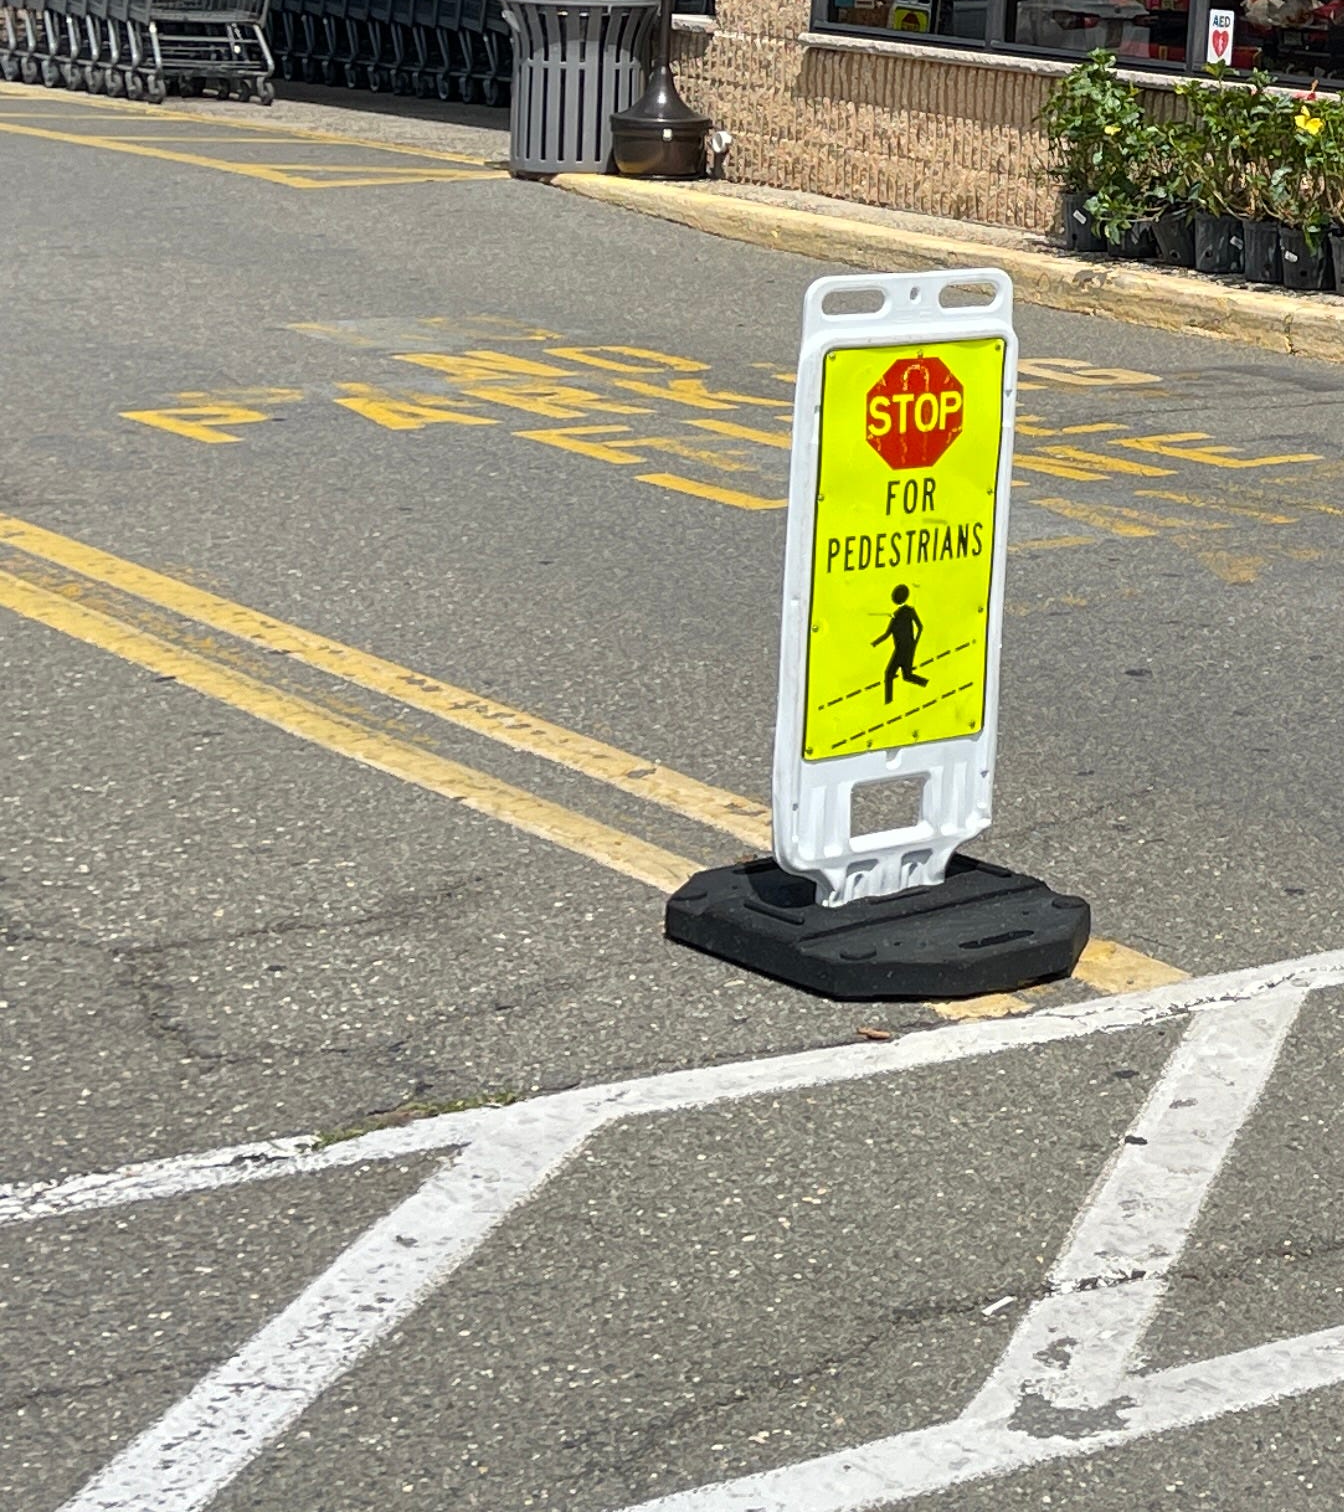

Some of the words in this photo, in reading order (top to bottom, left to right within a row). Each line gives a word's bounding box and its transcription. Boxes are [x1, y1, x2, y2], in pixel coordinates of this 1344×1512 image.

[1213, 14, 1230, 27] AED
[868, 390, 962, 436] STOP
[886, 477, 936, 516] FOR
[827, 522, 984, 573] PEDESTRIANS
